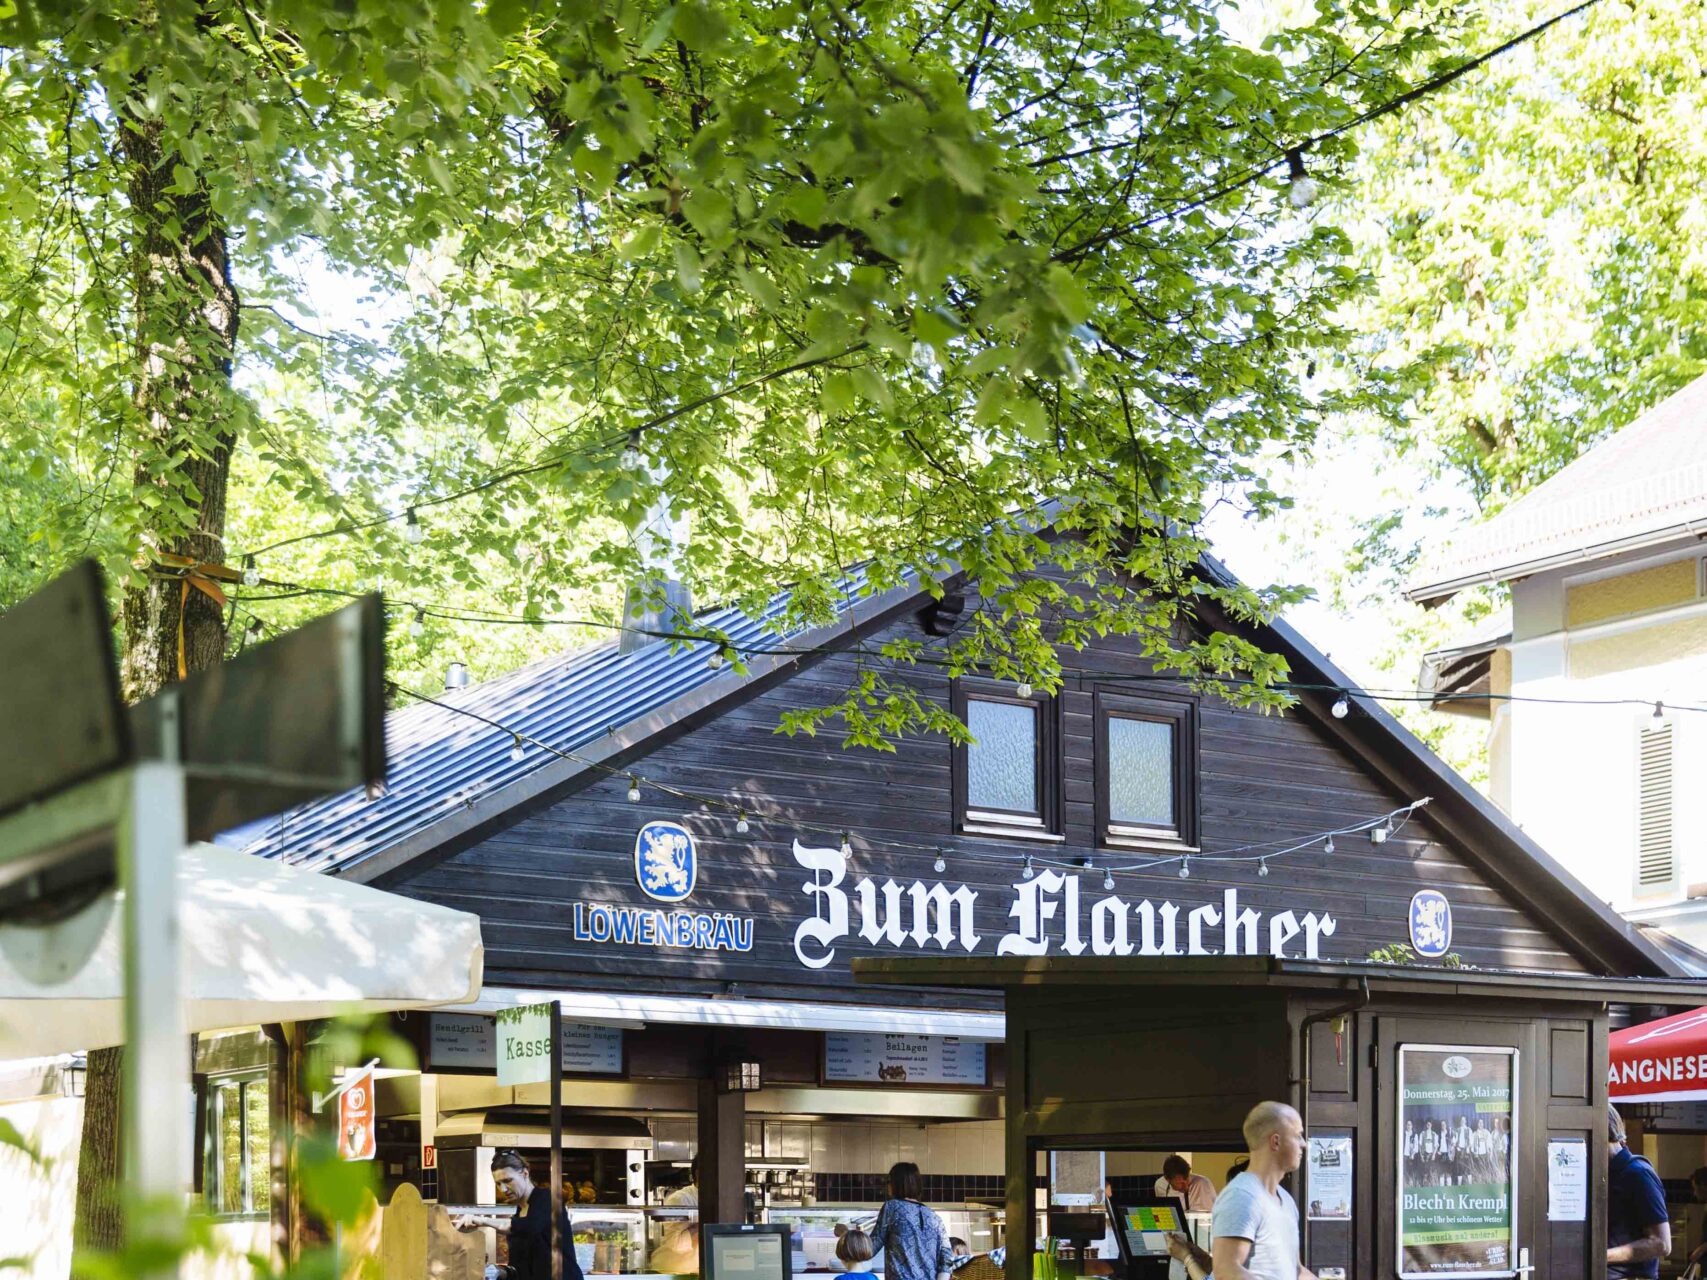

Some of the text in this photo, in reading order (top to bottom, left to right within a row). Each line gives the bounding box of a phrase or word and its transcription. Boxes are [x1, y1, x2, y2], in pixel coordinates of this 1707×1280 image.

[792, 838, 1337, 969] Zum Flaucher
[573, 902, 754, 952] LÖWENBRÄU
[435, 1023, 484, 1034] Hendlgrill
[506, 1037, 551, 1061] Kasse
[886, 1041, 928, 1054] Beilagen
[1608, 1054, 1707, 1085] ANGNESE
[1404, 1086, 1509, 1101] Donnerstag, 25. Mai 2017
[1404, 1193, 1508, 1214] Blech'n Krempl
[1417, 1216, 1426, 1224] bis
[1434, 1215, 1446, 1224] Uhr
[1447, 1215, 1456, 1224] bei
[1457, 1214, 1483, 1223] schönem
[1484, 1215, 1503, 1223] Wetter
